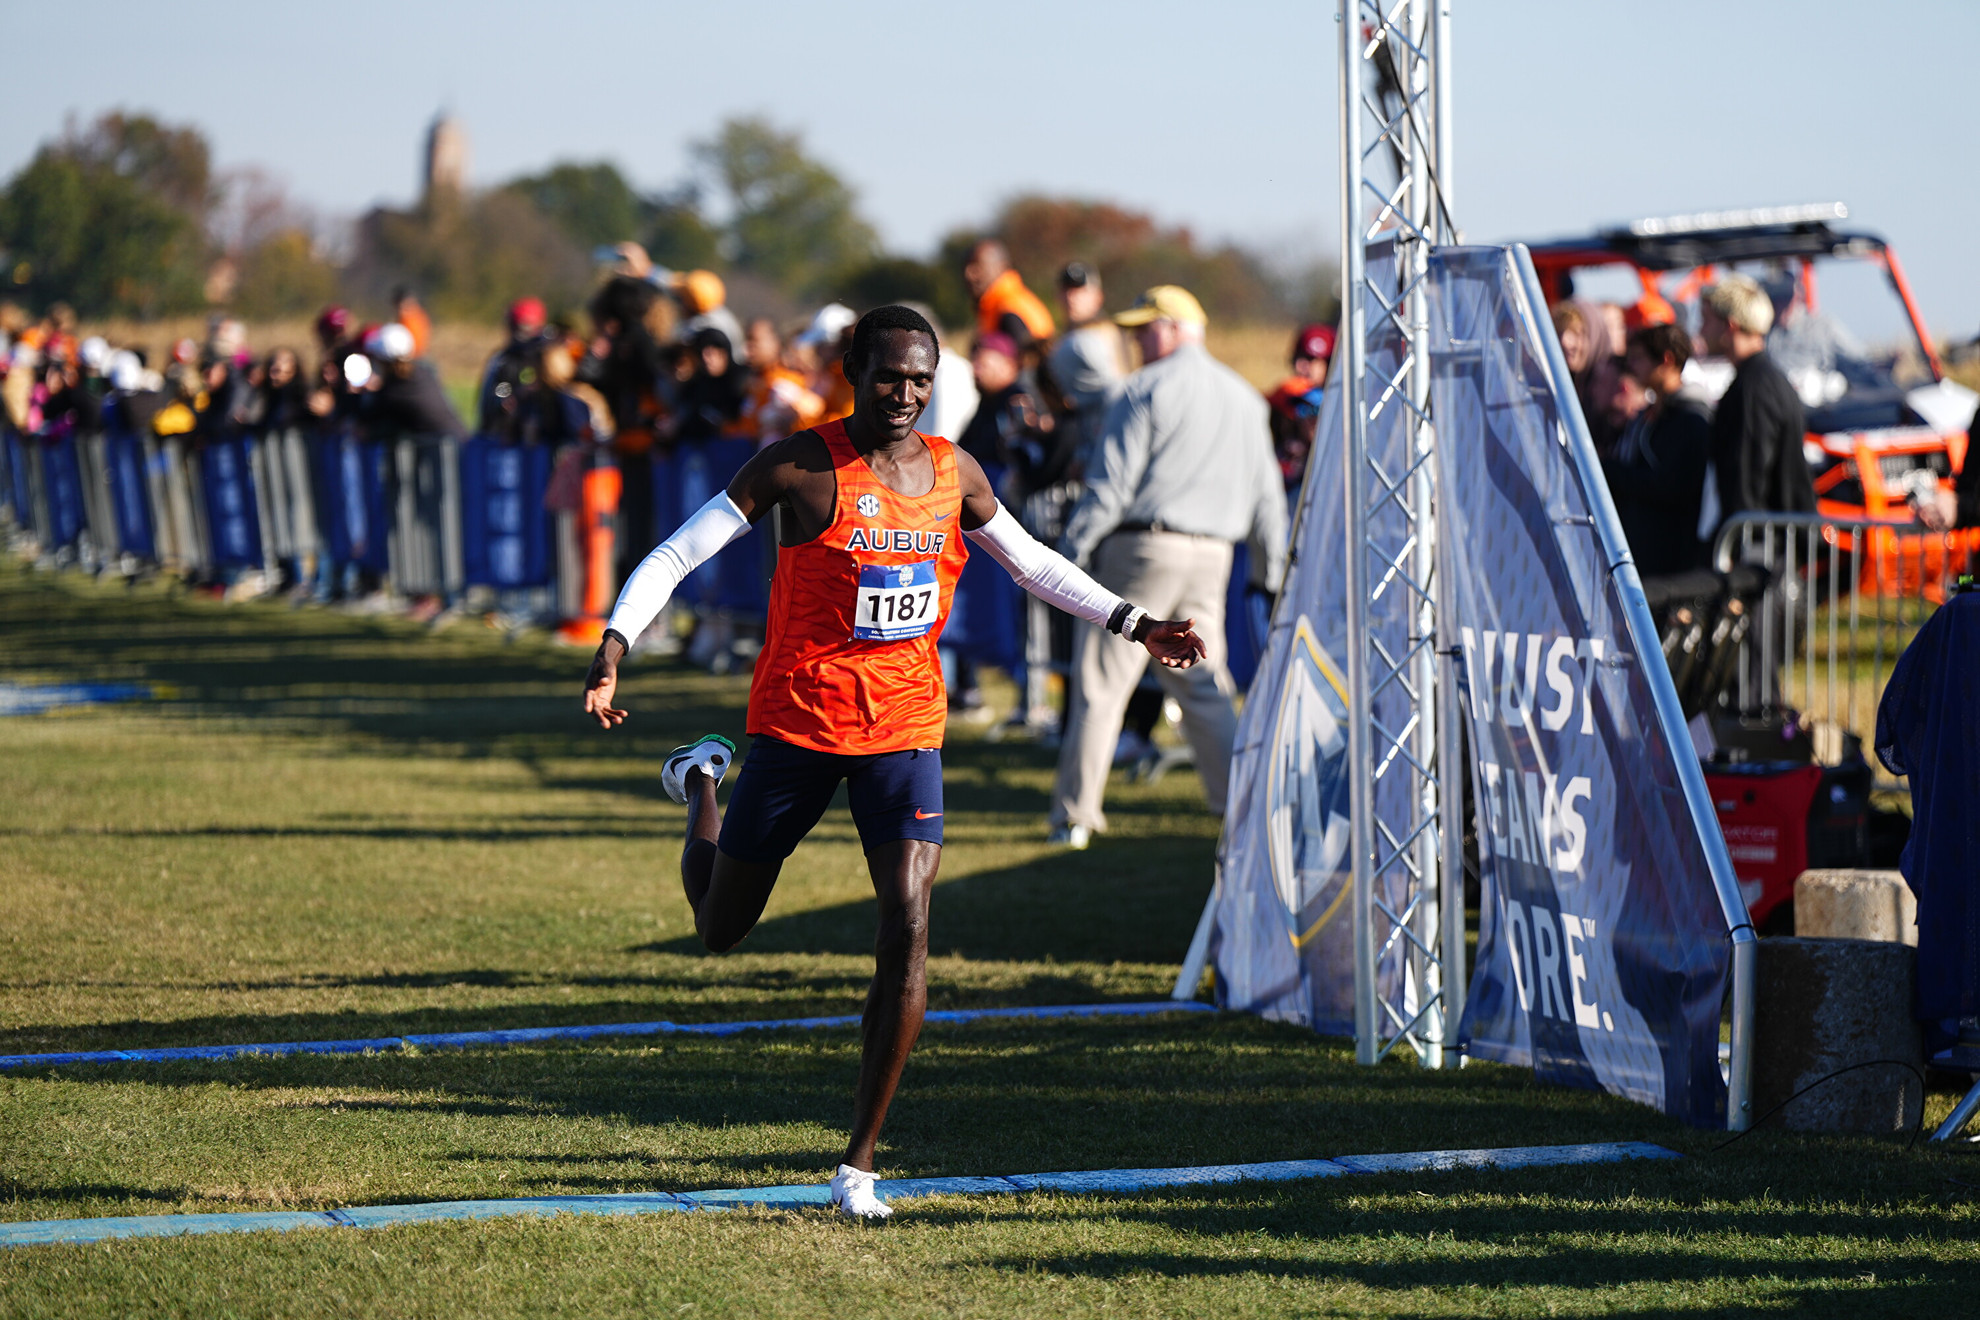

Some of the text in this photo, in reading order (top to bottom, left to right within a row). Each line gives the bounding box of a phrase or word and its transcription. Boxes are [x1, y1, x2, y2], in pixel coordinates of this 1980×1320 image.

[857, 494, 879, 517] SEC
[845, 528, 948, 554] AUBUR
[868, 590, 932, 623] 1187
[1479, 760, 1592, 873] EANS
